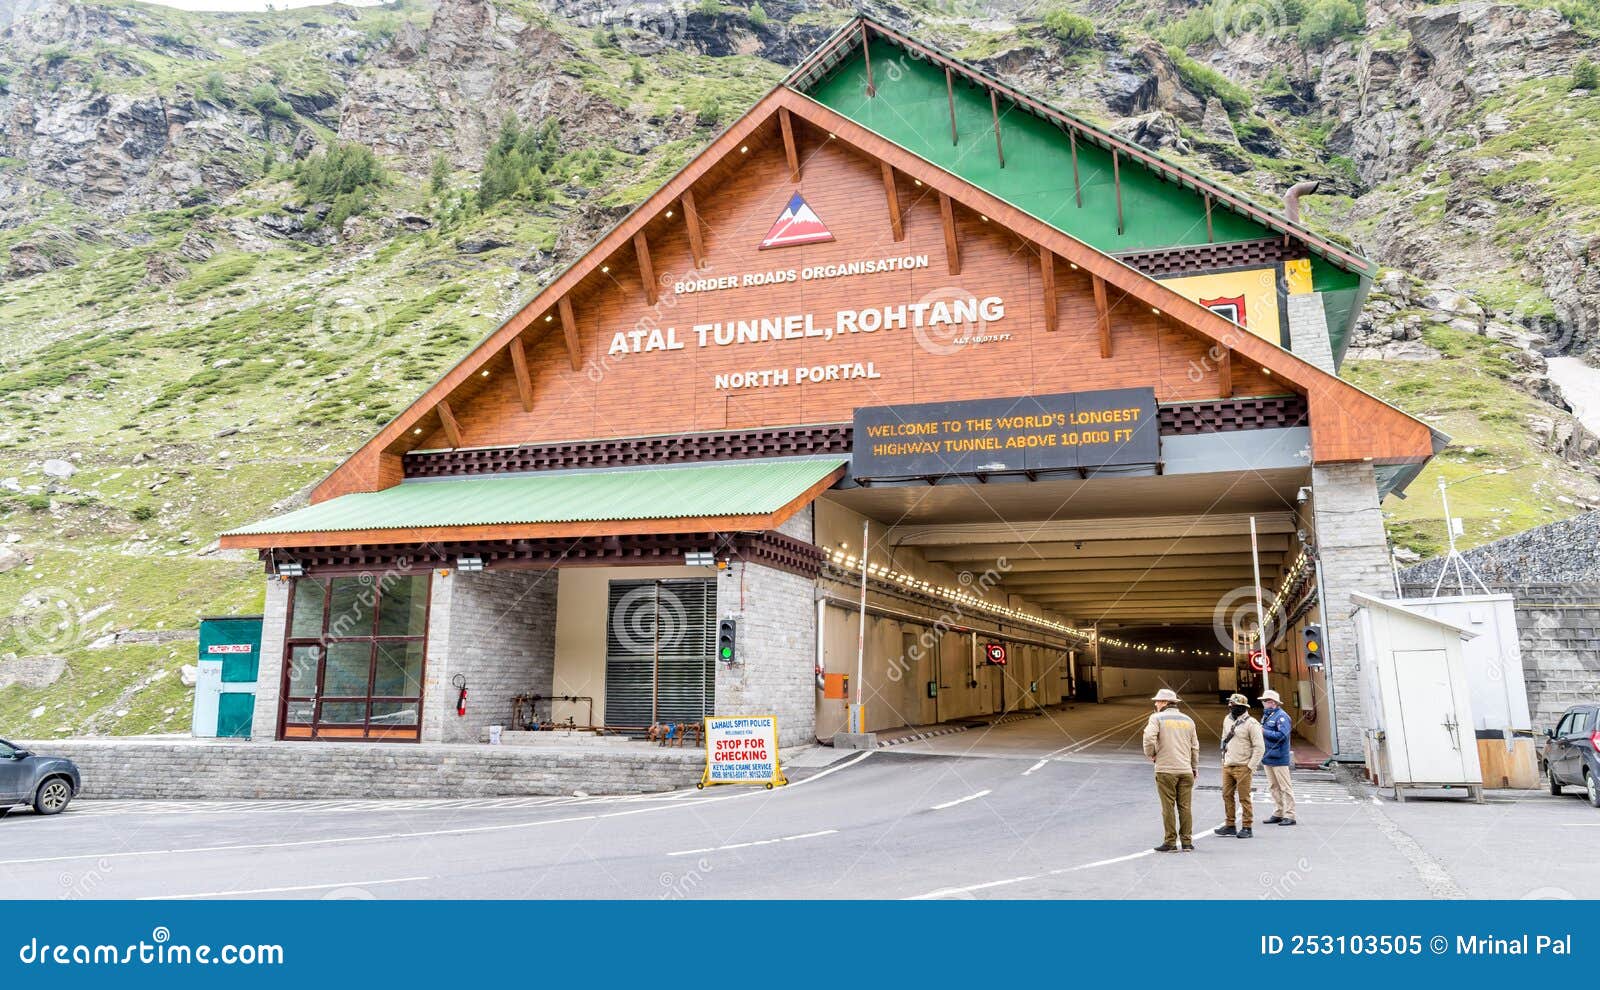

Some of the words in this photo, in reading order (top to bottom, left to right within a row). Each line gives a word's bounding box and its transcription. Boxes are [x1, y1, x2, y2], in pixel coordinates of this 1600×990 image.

[675, 276, 739, 294] BORDER
[743, 269, 798, 287] ROADS
[801, 255, 929, 281] ORGANISATION
[608, 328, 685, 355] ATAL
[714, 370, 789, 389] NORTH
[795, 362, 881, 385] PORTAL
[866, 422, 938, 438] WELCOME
[942, 420, 961, 433] TO
[965, 418, 993, 432] THE
[996, 413, 1065, 430] WORLD'S
[1070, 408, 1140, 425] LONGEST
[873, 441, 940, 456] HIGHWAY
[944, 437, 1002, 452] TUNNEL
[1005, 434, 1057, 449] ABOVE
[1061, 430, 1110, 447] 10,000
[1114, 429, 1133, 443] FT
[992, 650, 1001, 658] 40
[711, 720, 733, 729] LAHAUL
[734, 720, 749, 728] SPITI
[750, 719, 771, 727] POLICE
[714, 750, 767, 761] CHECKING
[716, 740, 741, 750] STOP
[744, 739, 764, 749] FOR
